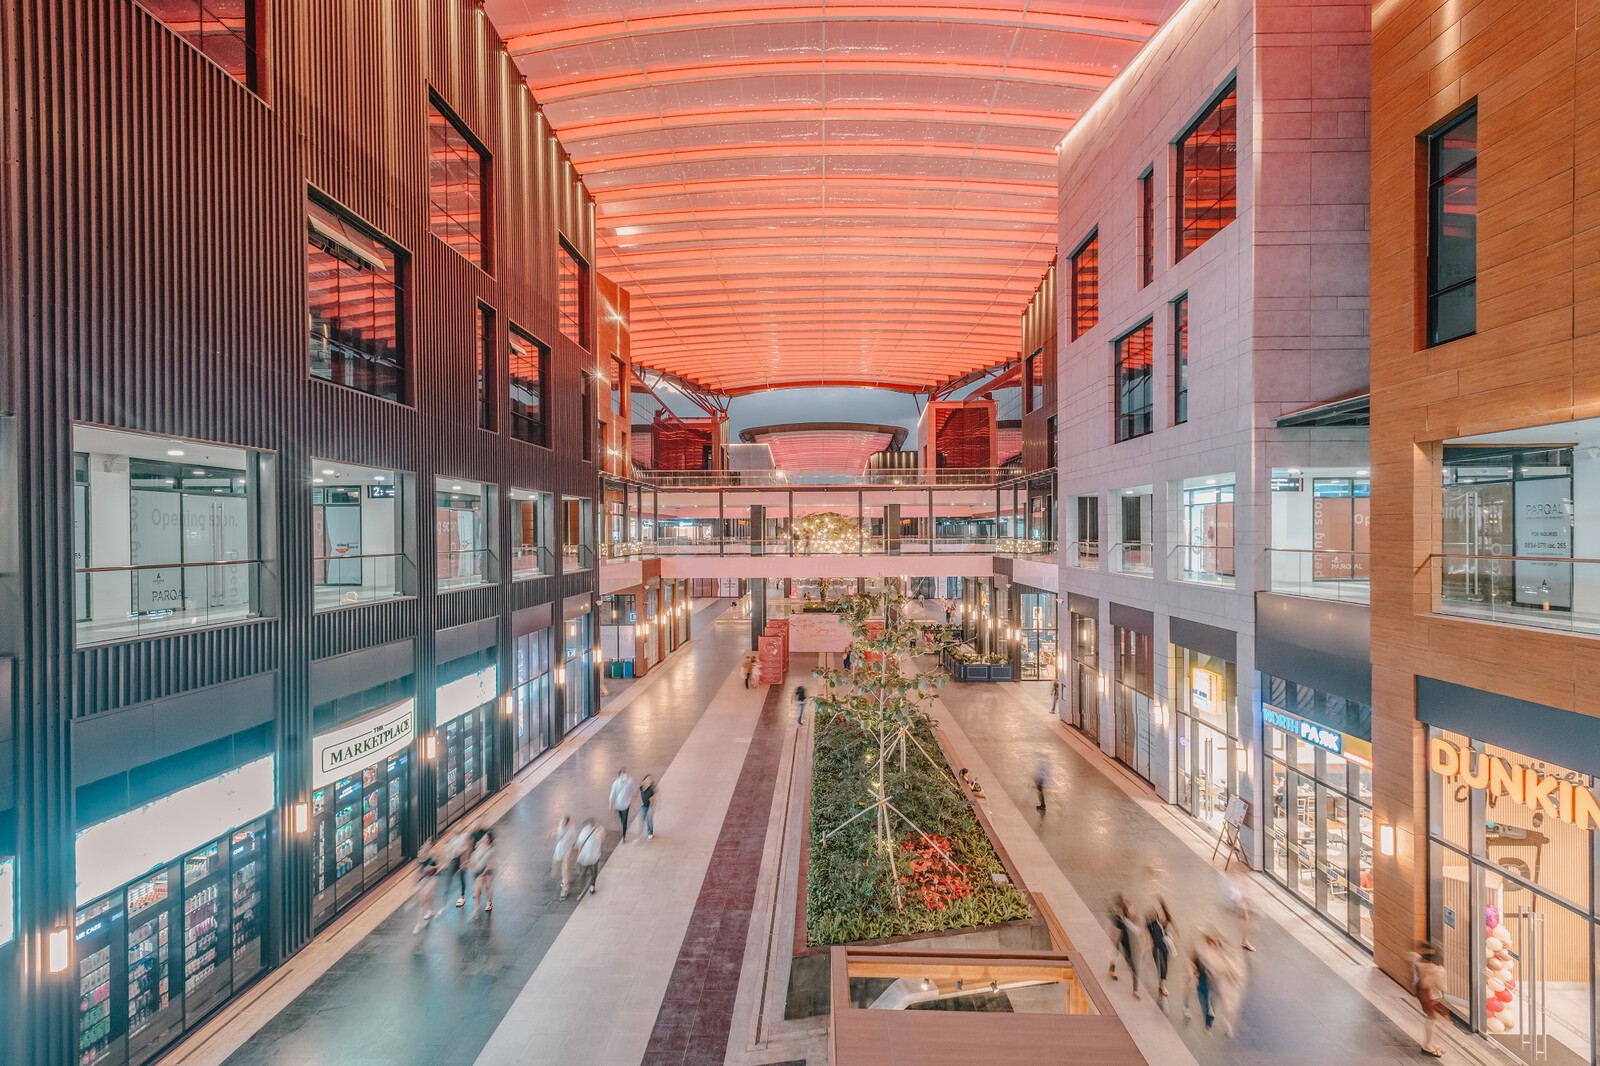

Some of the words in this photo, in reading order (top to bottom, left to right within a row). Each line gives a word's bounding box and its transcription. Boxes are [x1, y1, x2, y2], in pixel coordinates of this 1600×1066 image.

[1526, 503, 1563, 515] PARQAL
[1314, 532, 1325, 578] penng
[330, 718, 410, 766] MARKETPLACE
[373, 724, 384, 733] THE
[1262, 707, 1299, 735] NORTH
[1301, 722, 1339, 751] PARK
[1431, 737, 1600, 831] DUNKIN
